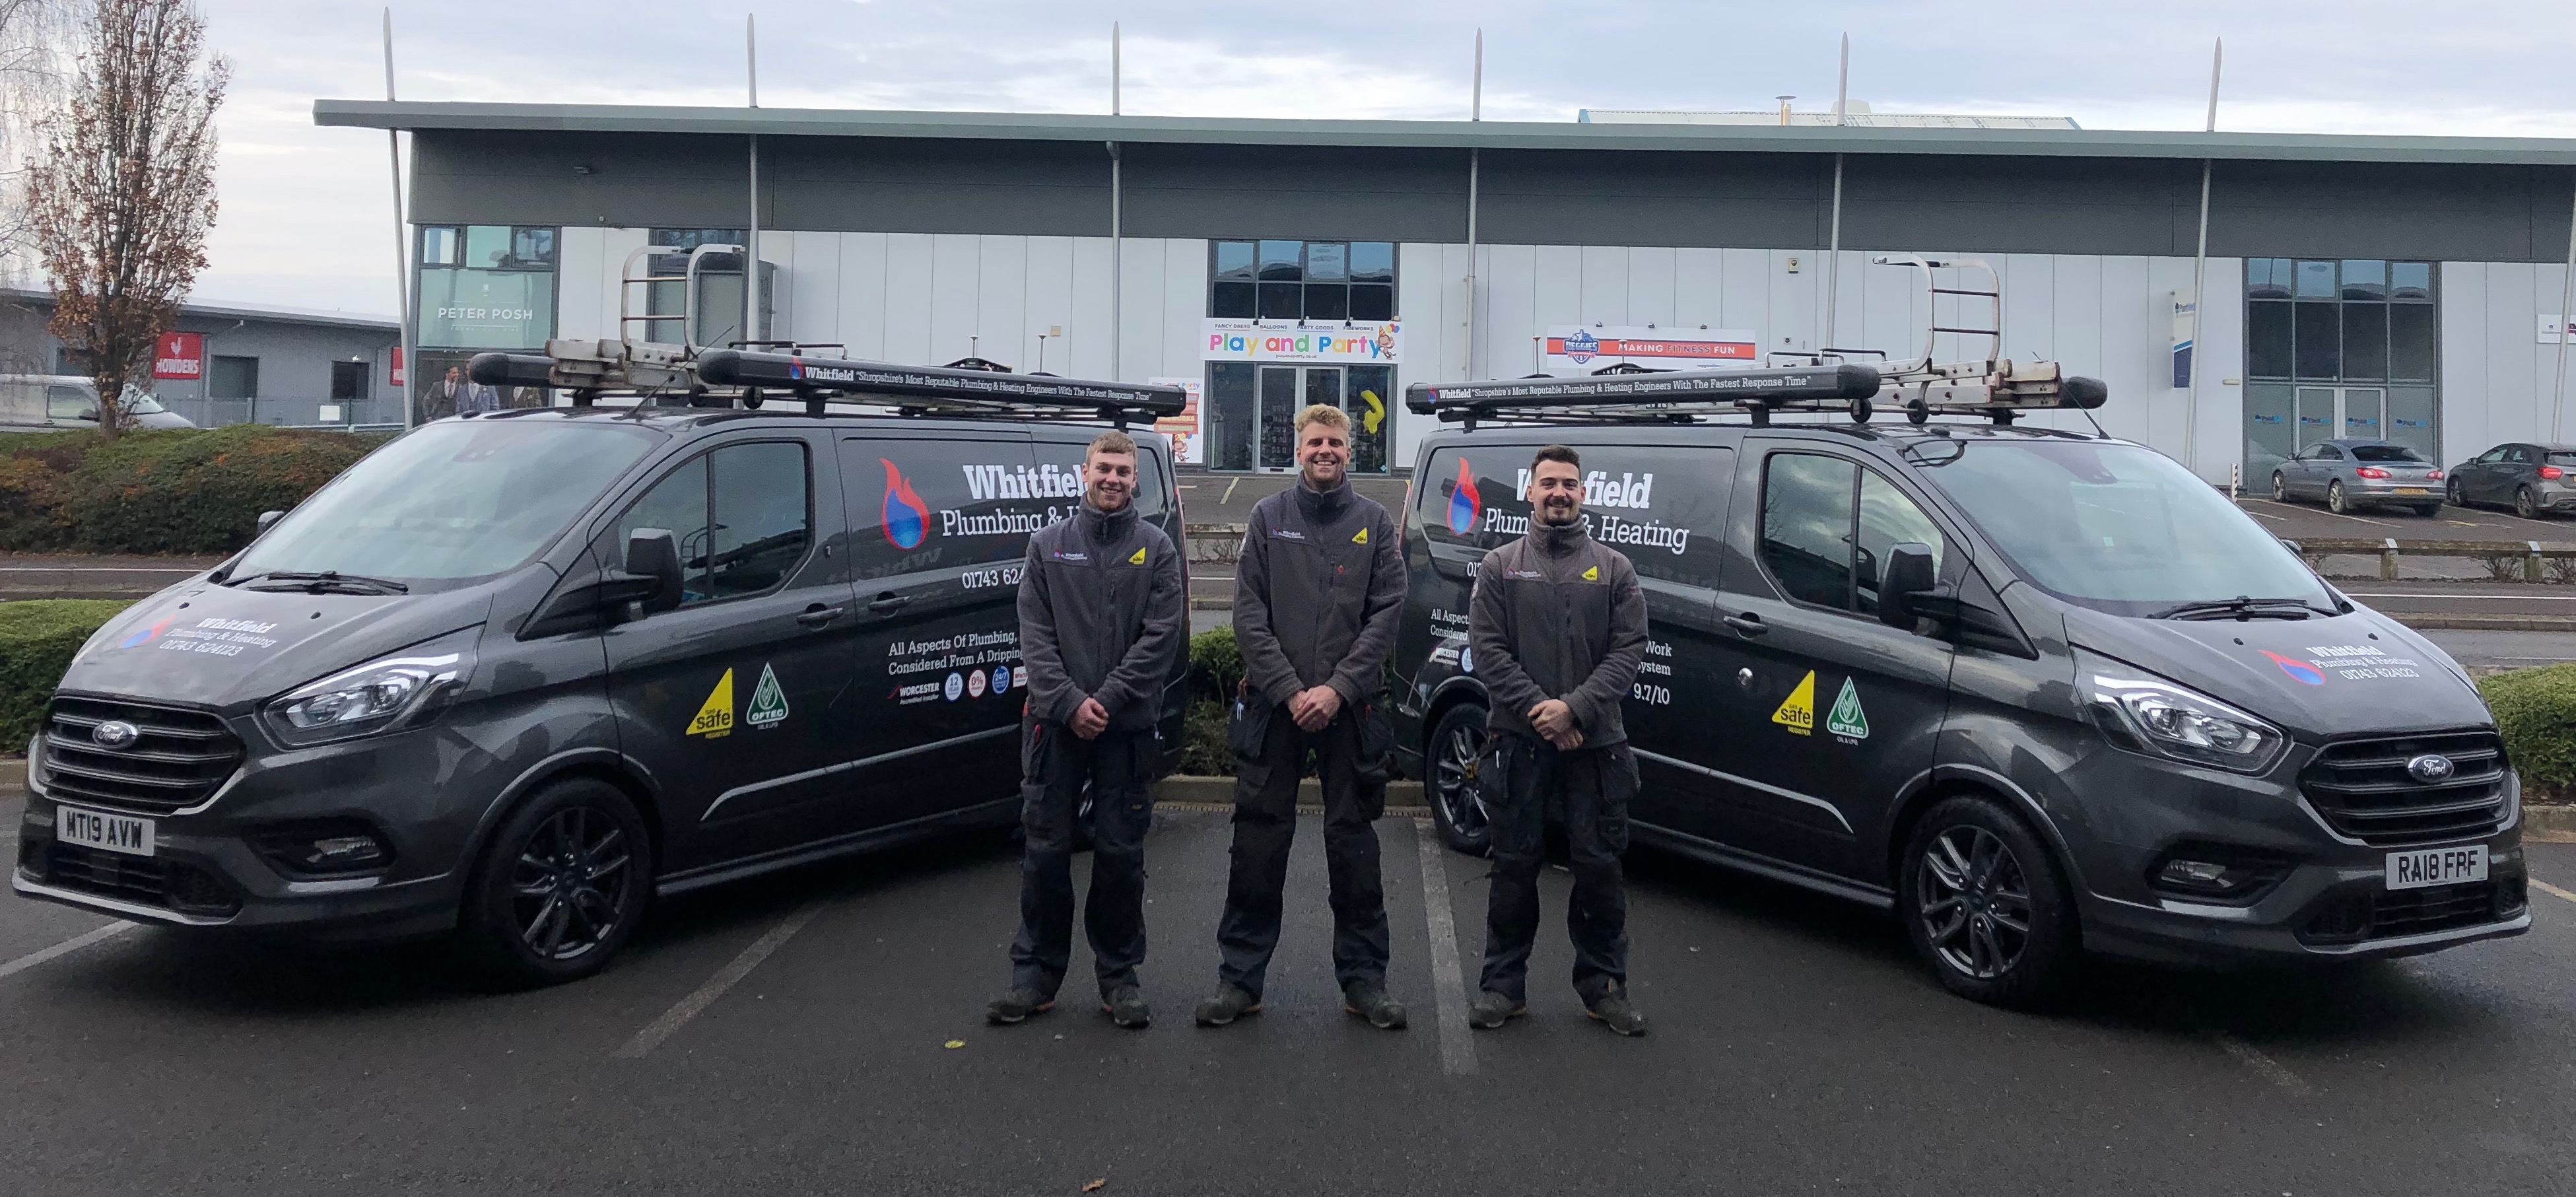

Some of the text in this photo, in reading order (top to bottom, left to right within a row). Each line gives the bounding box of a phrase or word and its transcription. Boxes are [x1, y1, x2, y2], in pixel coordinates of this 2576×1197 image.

[438, 308, 533, 320] PETER POSH
[1209, 333, 1380, 359] Play and Party
[1617, 343, 1663, 352] MAKING
[1667, 345, 1711, 353] FITNESS
[155, 358, 199, 374] HOWDENS
[805, 366, 854, 381] Whitfield
[905, 374, 923, 384] Most
[924, 376, 959, 388] Reputable
[961, 378, 992, 392] Plumbing
[993, 382, 999, 390] &
[1000, 382, 1025, 393] Heating
[1026, 384, 1057, 395] Engineers
[1058, 386, 1073, 395] With
[1073, 387, 1086, 396] The
[1086, 388, 1107, 397] Fastest
[1108, 390, 1134, 401] Response
[1439, 388, 1471, 399] Whitfield
[1512, 386, 1528, 395] Most
[1529, 384, 1562, 396] Reputable
[1563, 382, 1595, 395] Plumbing
[1596, 383, 1603, 392] &
[1604, 382, 1633, 393] Heating
[1634, 380, 1671, 392] Engineers
[1673, 380, 1691, 390] With
[1693, 379, 1709, 389] The
[1710, 378, 1741, 389] Fastest
[1742, 376, 1783, 388] Response
[963, 463, 1088, 500] Whitfiel
[940, 508, 1042, 537] Plumbing
[1048, 506, 1063, 526] &
[1483, 507, 1535, 535] Plum
[1598, 515, 1690, 555] Heating
[962, 569, 999, 589] 01743
[1431, 608, 1441, 621] All
[196, 617, 277, 633] Whitfield
[1430, 624, 1469, 641] Considered
[164, 629, 278, 648] Plumbing & Heating
[888, 641, 905, 656] All
[907, 638, 951, 655] Aspects
[953, 634, 966, 648] Of
[159, 640, 243, 656] 01743 624123
[2305, 645, 2387, 657] Whitfield
[888, 656, 947, 675] Considered
[949, 653, 974, 667] From
[976, 651, 985, 664] A
[2309, 657, 2419, 668] Plumbing & Heating
[950, 676, 959, 687] 12
[971, 676, 983, 686] 0%
[995, 673, 1006, 681] 24/7
[2339, 667, 2420, 680] 01743 624123
[900, 682, 939, 697] WORCESTER
[1633, 682, 1670, 706] 9.7/10
[696, 709, 731, 730] safe
[752, 709, 784, 721] OFTEC
[1780, 706, 1811, 724] safe
[98, 724, 124, 742] Ford
[1831, 722, 1864, 735] OFTEC
[2423, 759, 2447, 776] Ford
[107, 818, 142, 849] AVW
[2398, 853, 2439, 883] RA18
